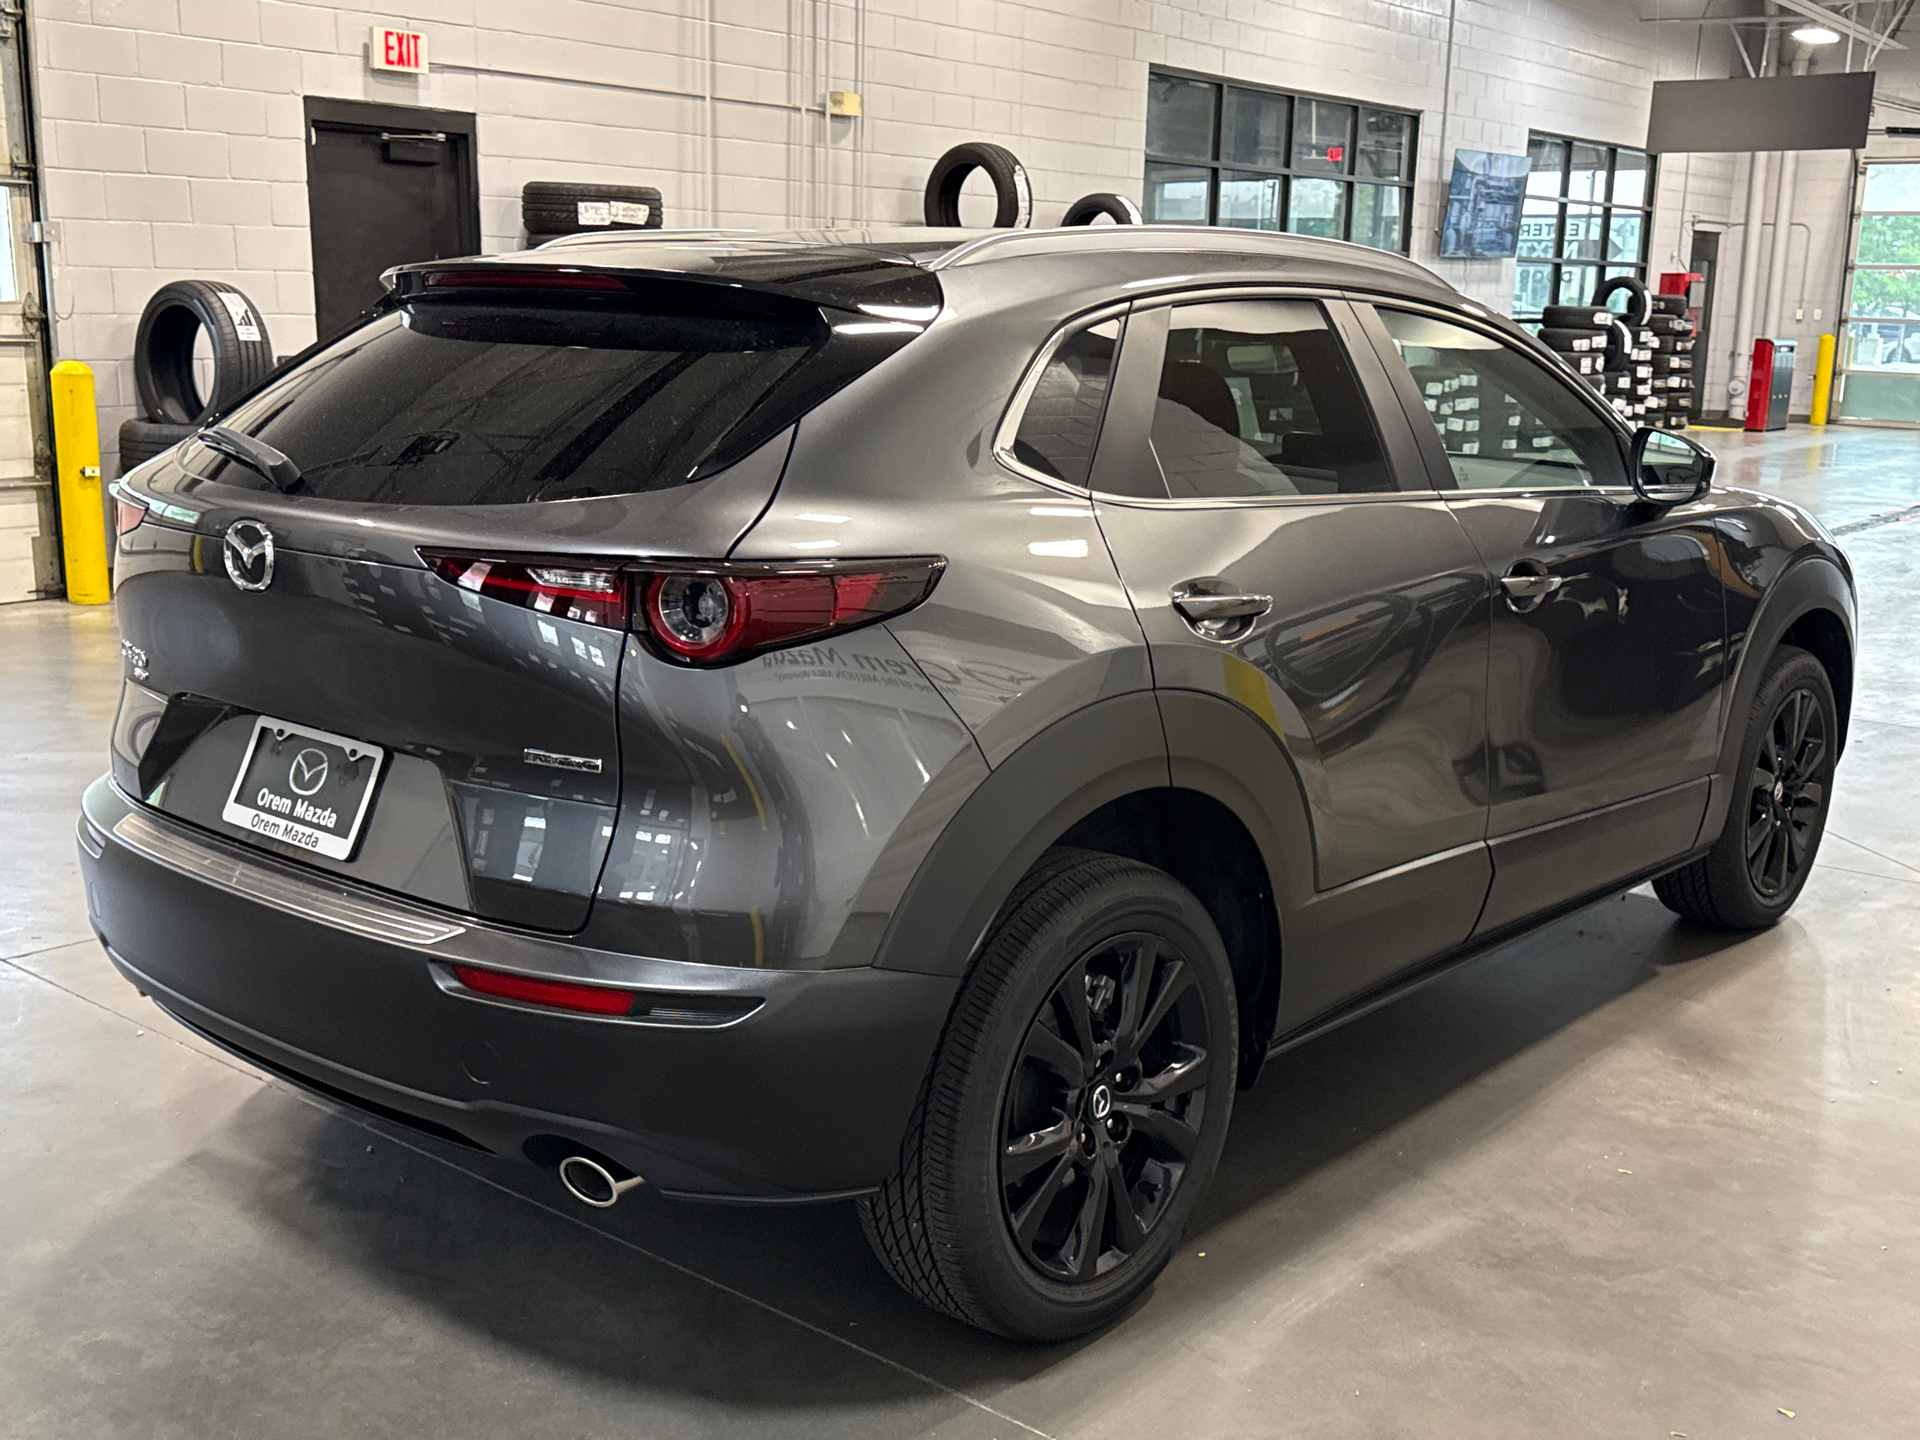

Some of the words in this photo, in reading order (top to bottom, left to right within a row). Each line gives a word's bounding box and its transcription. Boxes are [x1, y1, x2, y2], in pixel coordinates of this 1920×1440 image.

[384, 30, 420, 69] EXIT
[257, 787, 292, 814] Orem
[293, 798, 337, 828] Mazda
[251, 813, 280, 835] Orem
[281, 823, 319, 848] Mazda
